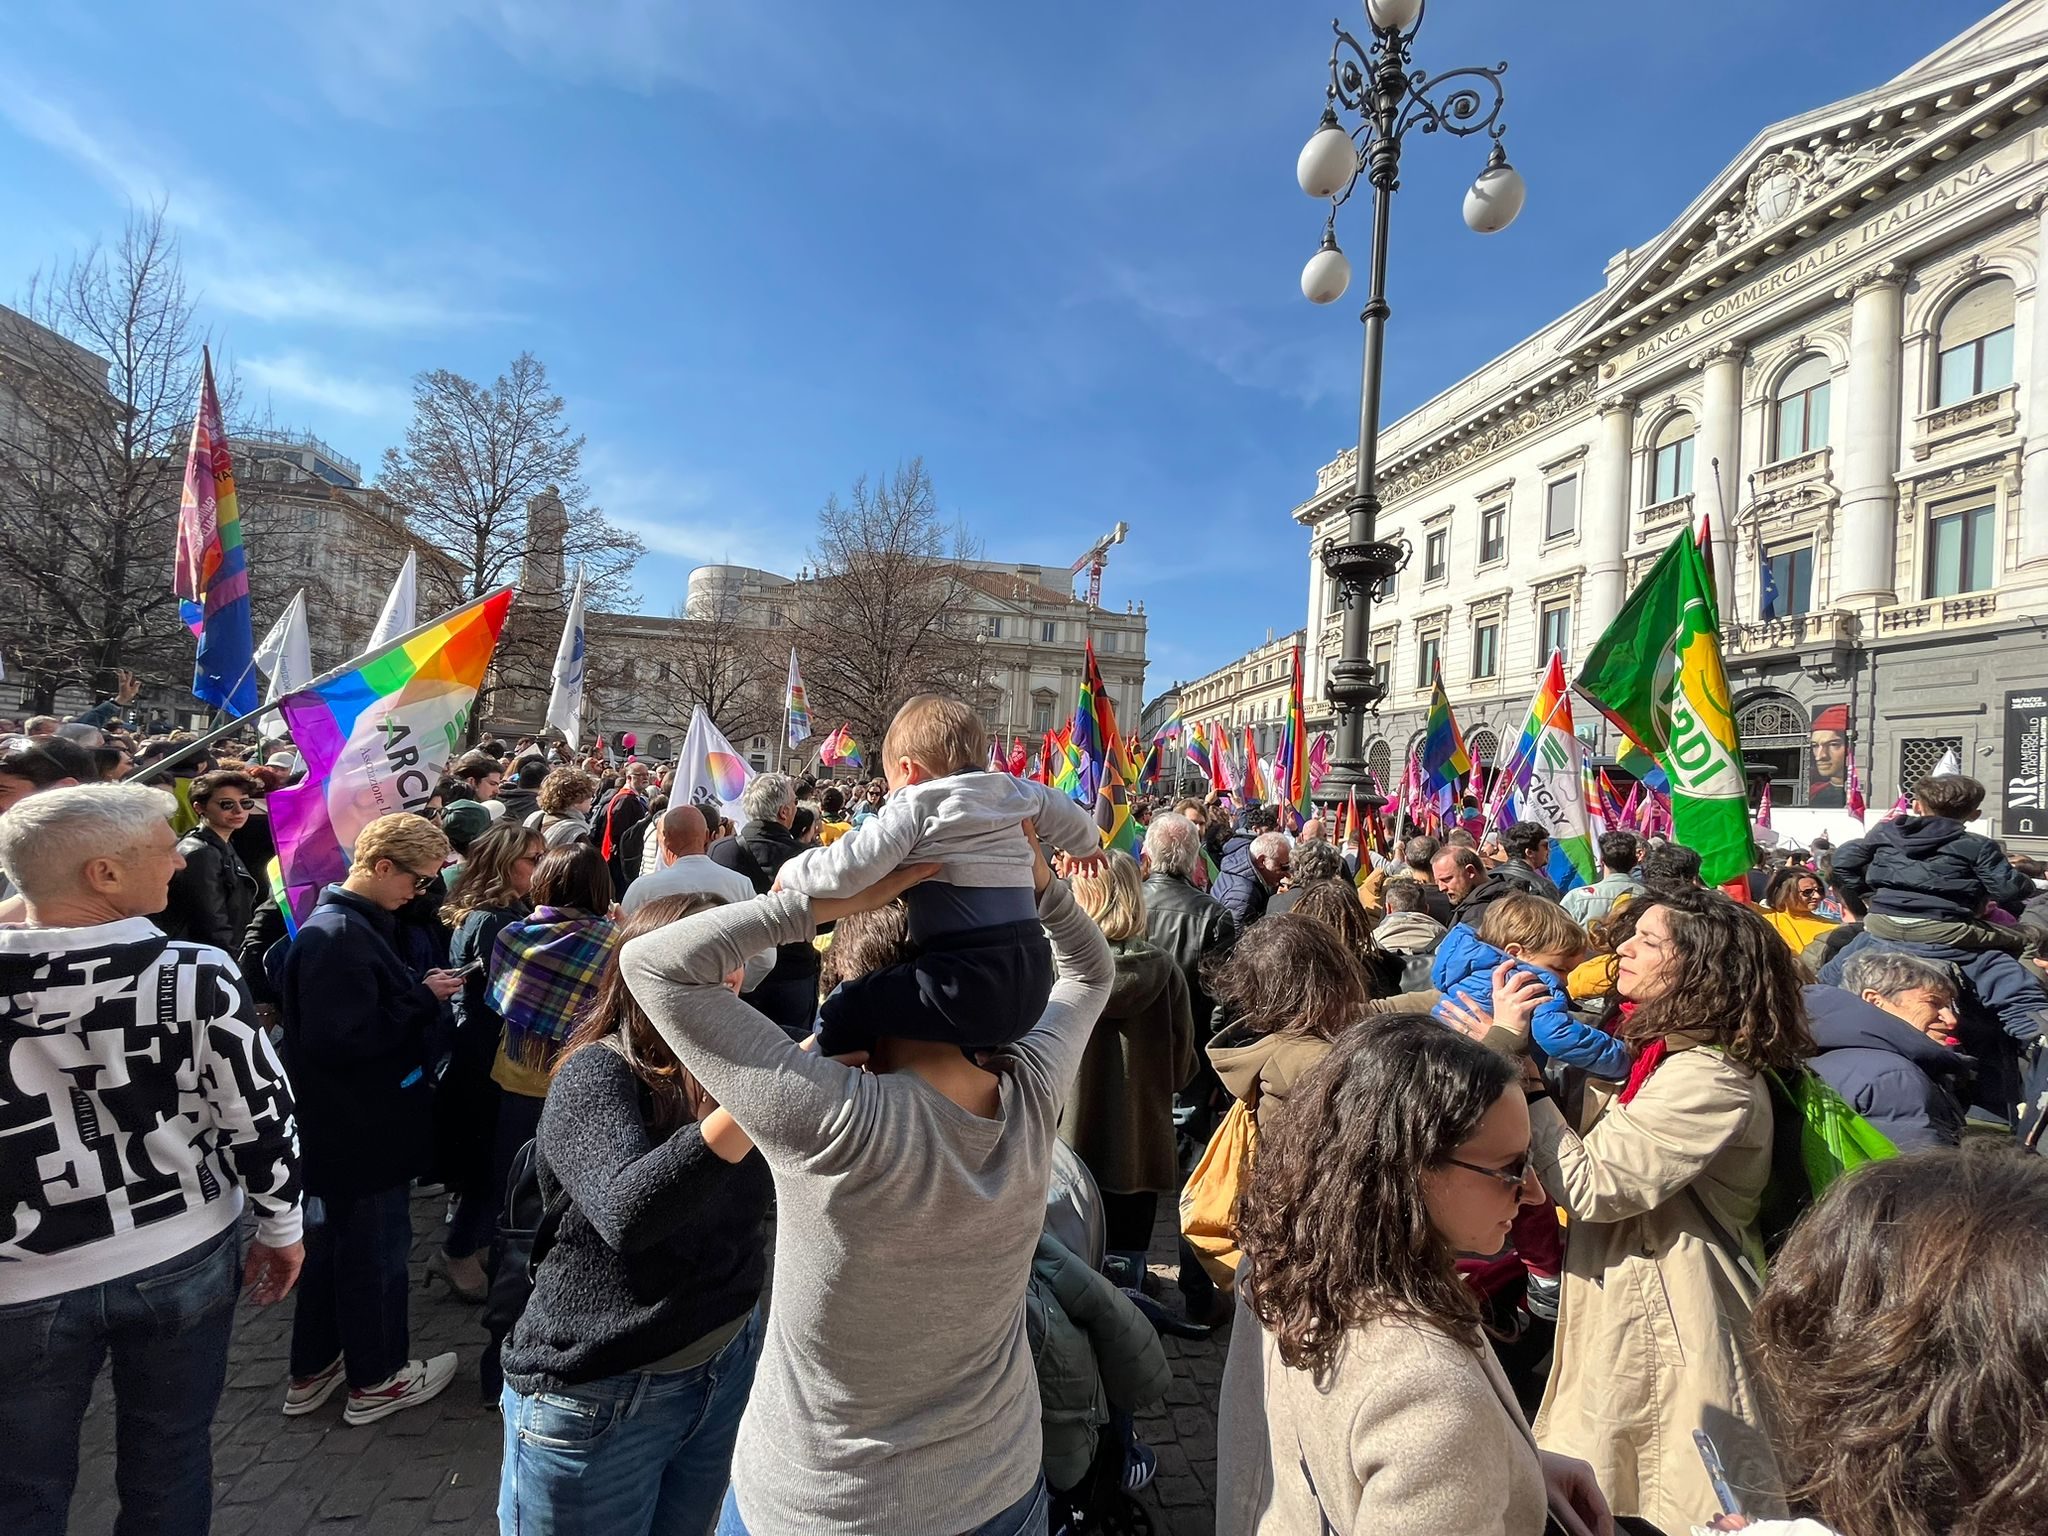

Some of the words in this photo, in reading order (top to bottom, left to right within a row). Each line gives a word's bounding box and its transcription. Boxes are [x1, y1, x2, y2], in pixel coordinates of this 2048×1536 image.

[1636, 324, 1692, 361] BANCA
[1701, 240, 1848, 327] COMMERCIALE
[1861, 163, 1996, 244] ITALIANA
[360, 747, 385, 805] Associazione
[160, 964, 176, 1024] HILFIGER
